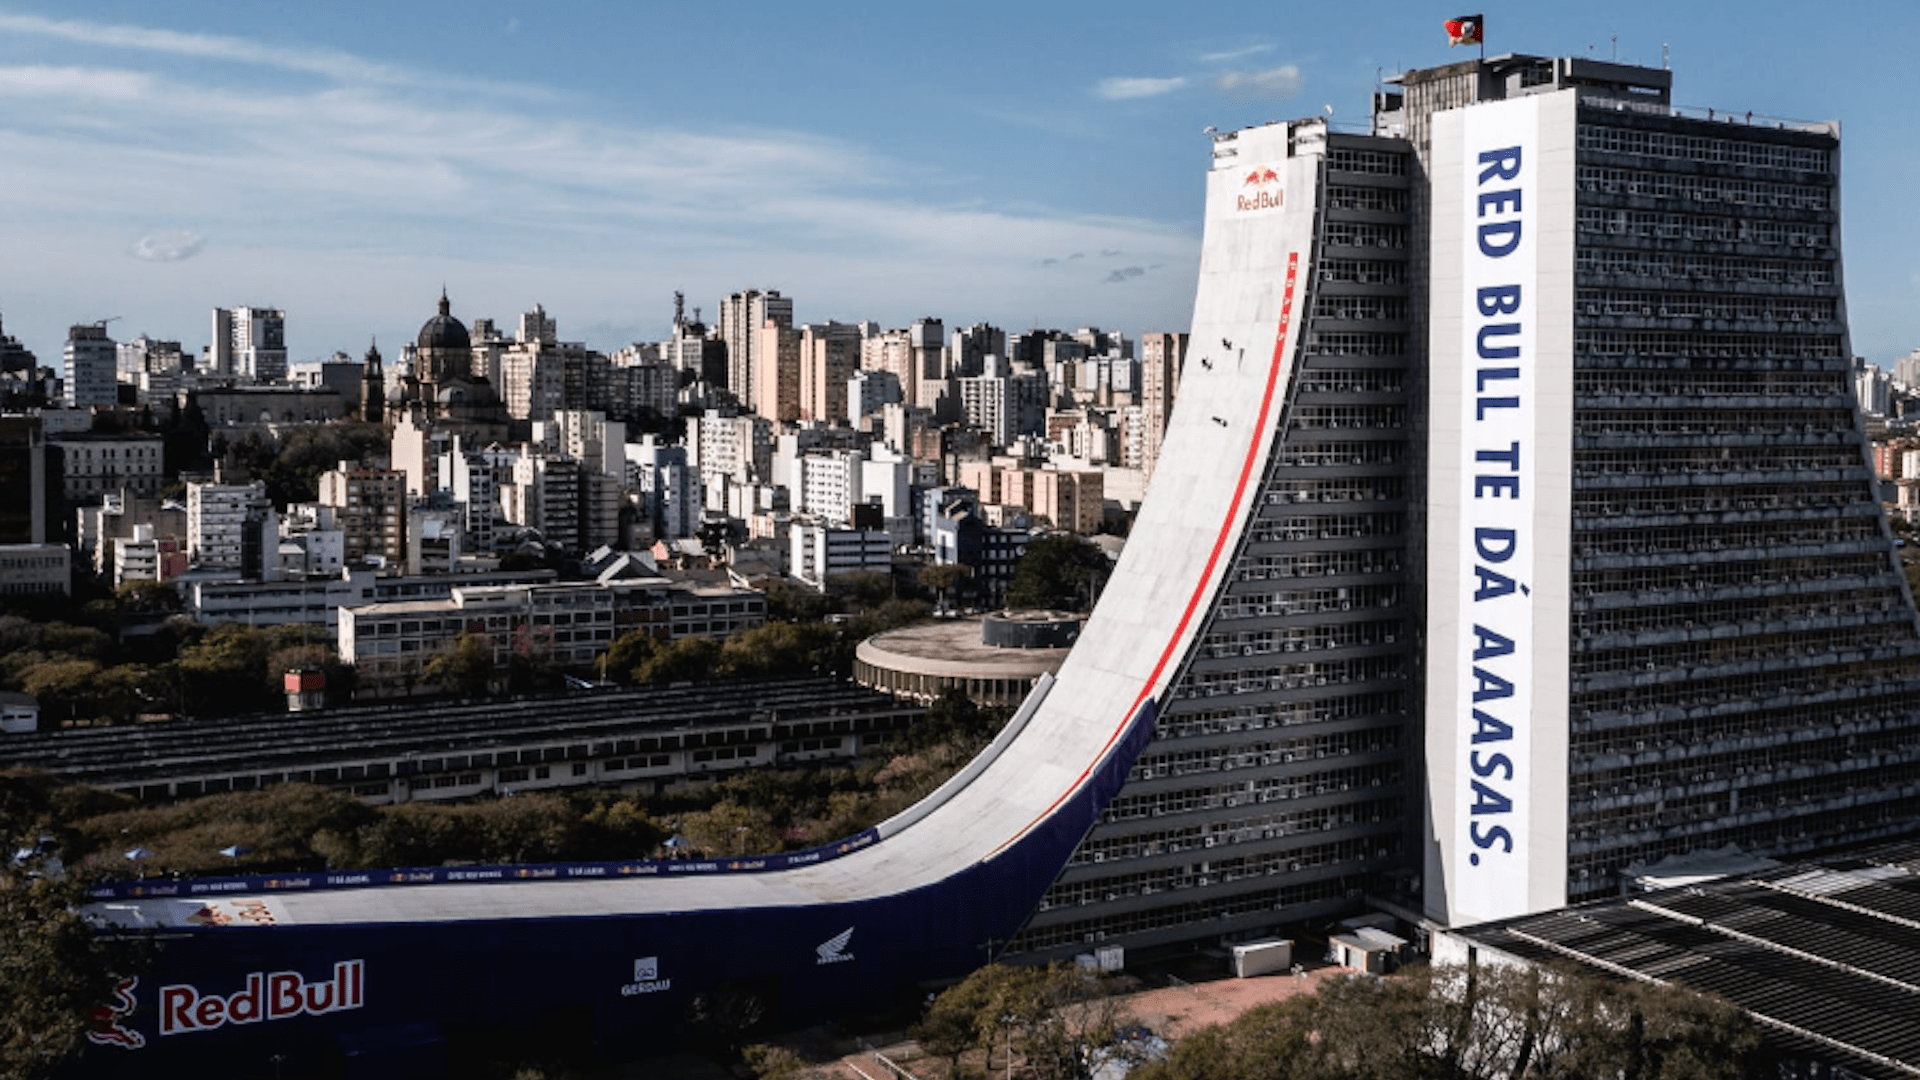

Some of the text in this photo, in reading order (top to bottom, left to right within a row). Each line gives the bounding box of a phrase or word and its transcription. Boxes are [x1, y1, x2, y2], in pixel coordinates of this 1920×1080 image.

[1237, 189, 1284, 211] Red Bull
[1469, 146, 1528, 866] RED BULL TE DÁ AAASAS.
[159, 959, 364, 1036] Red Bull
